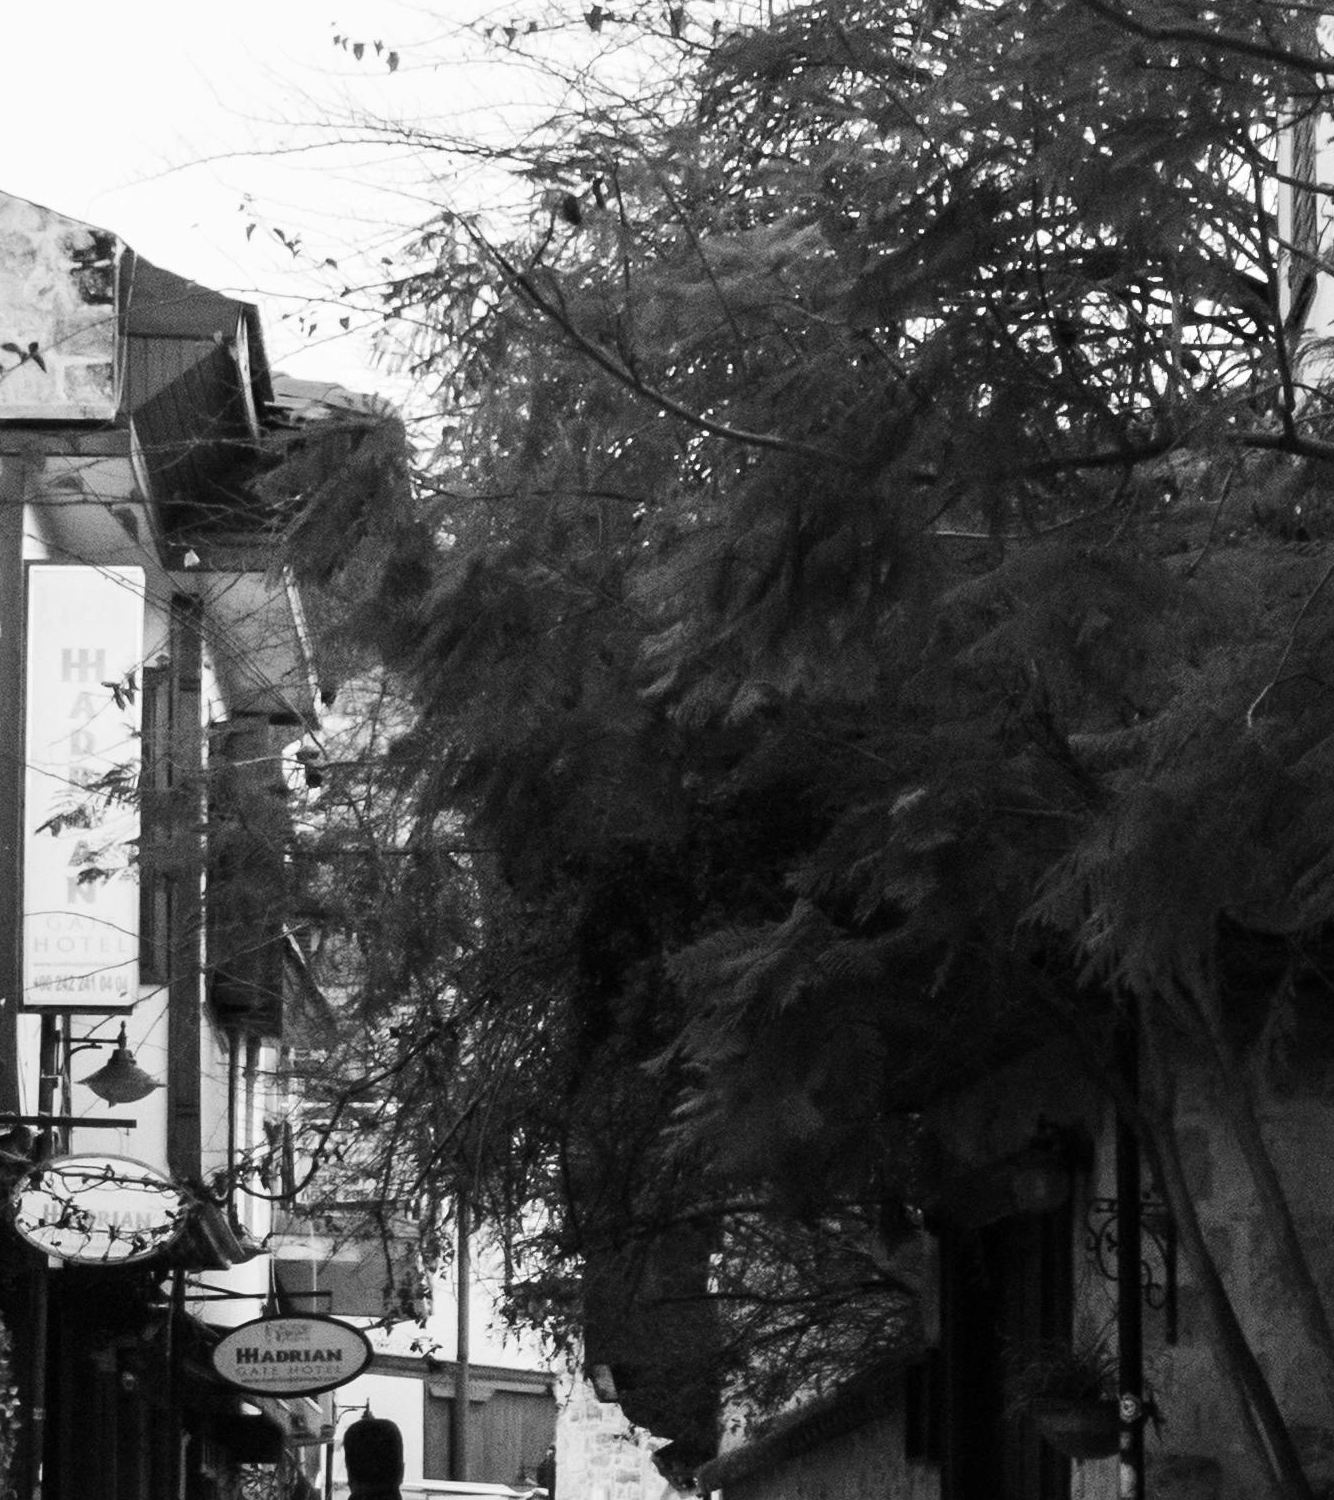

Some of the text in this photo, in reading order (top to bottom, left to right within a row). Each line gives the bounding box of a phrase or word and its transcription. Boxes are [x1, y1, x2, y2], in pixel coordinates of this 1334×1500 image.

[32, 936, 128, 953] HOTEL
[234, 1364, 343, 1378] GATE HOTEL
